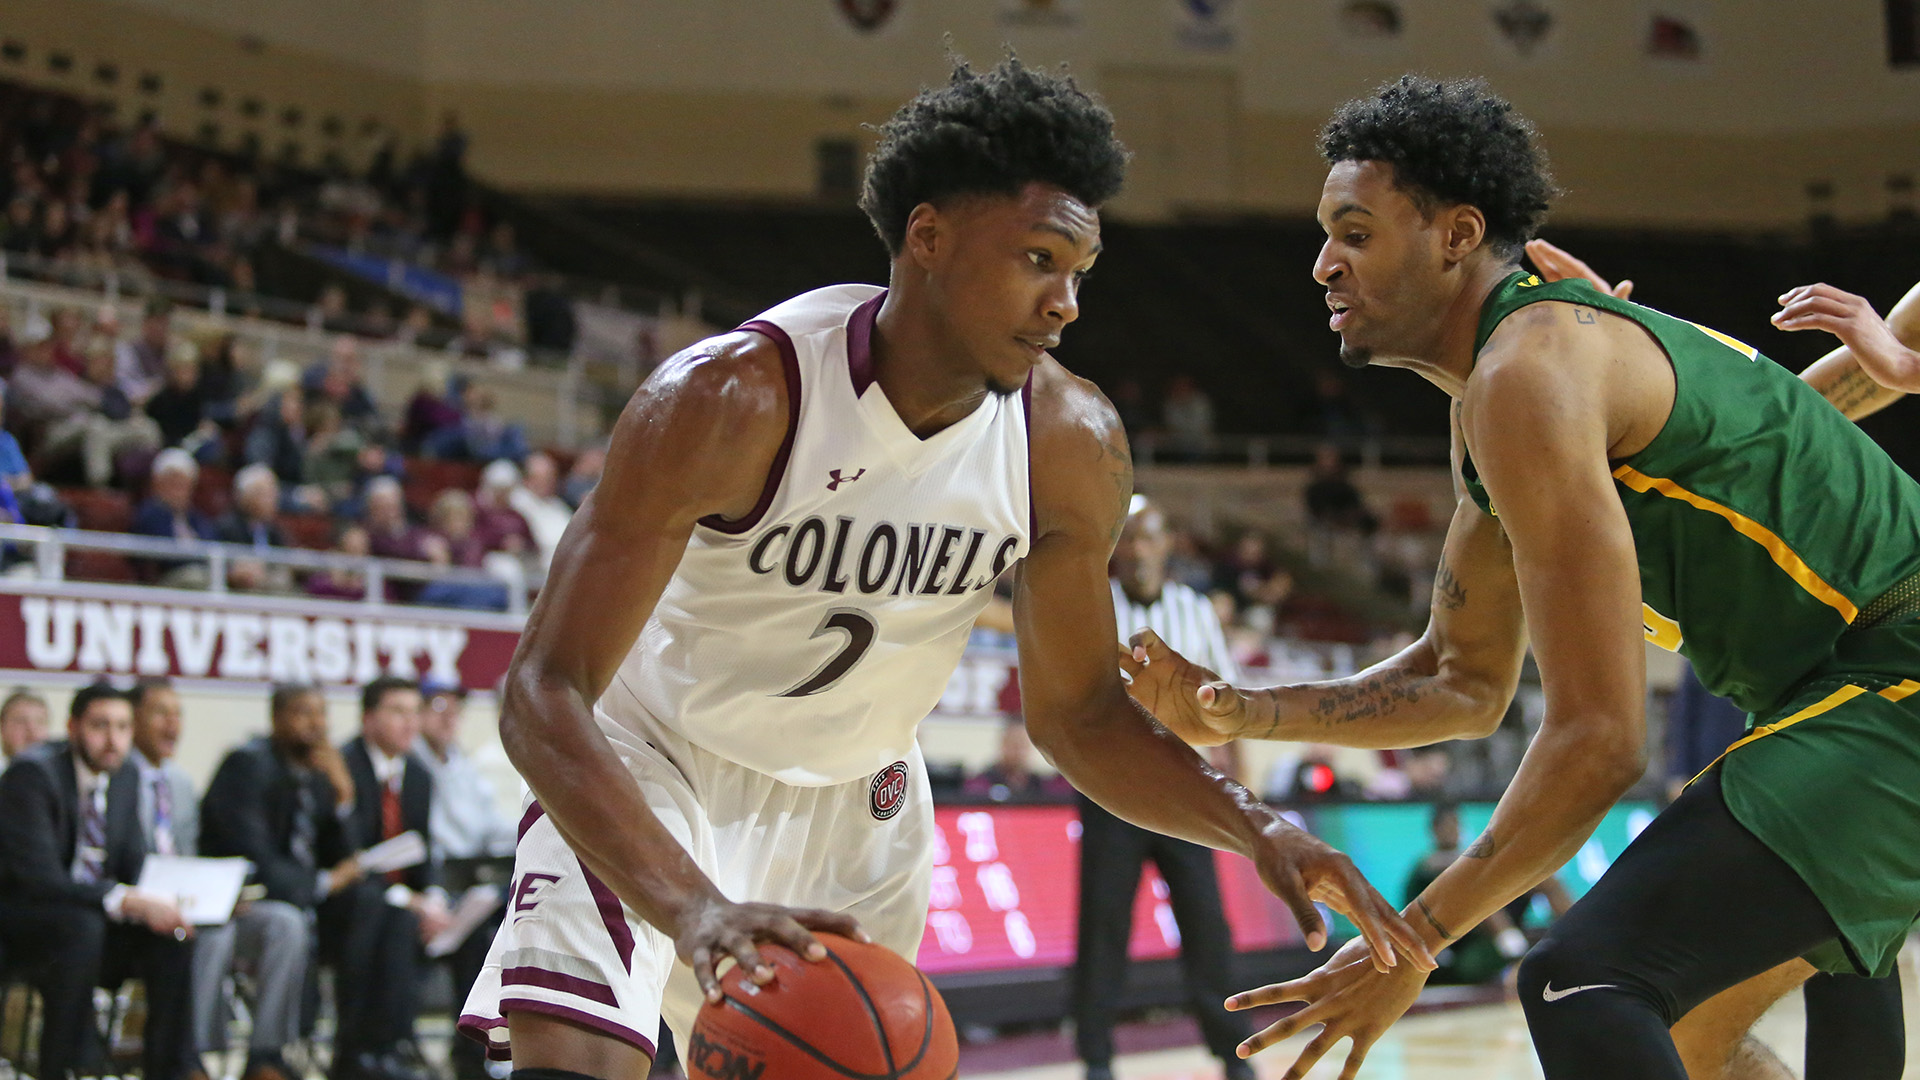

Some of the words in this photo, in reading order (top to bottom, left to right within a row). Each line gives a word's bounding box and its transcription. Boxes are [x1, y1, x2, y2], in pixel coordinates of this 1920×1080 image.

[747, 514, 1021, 597] COLONELS
[20, 596, 470, 690] UNIVERSITY
[880, 776, 902, 806] OVC
